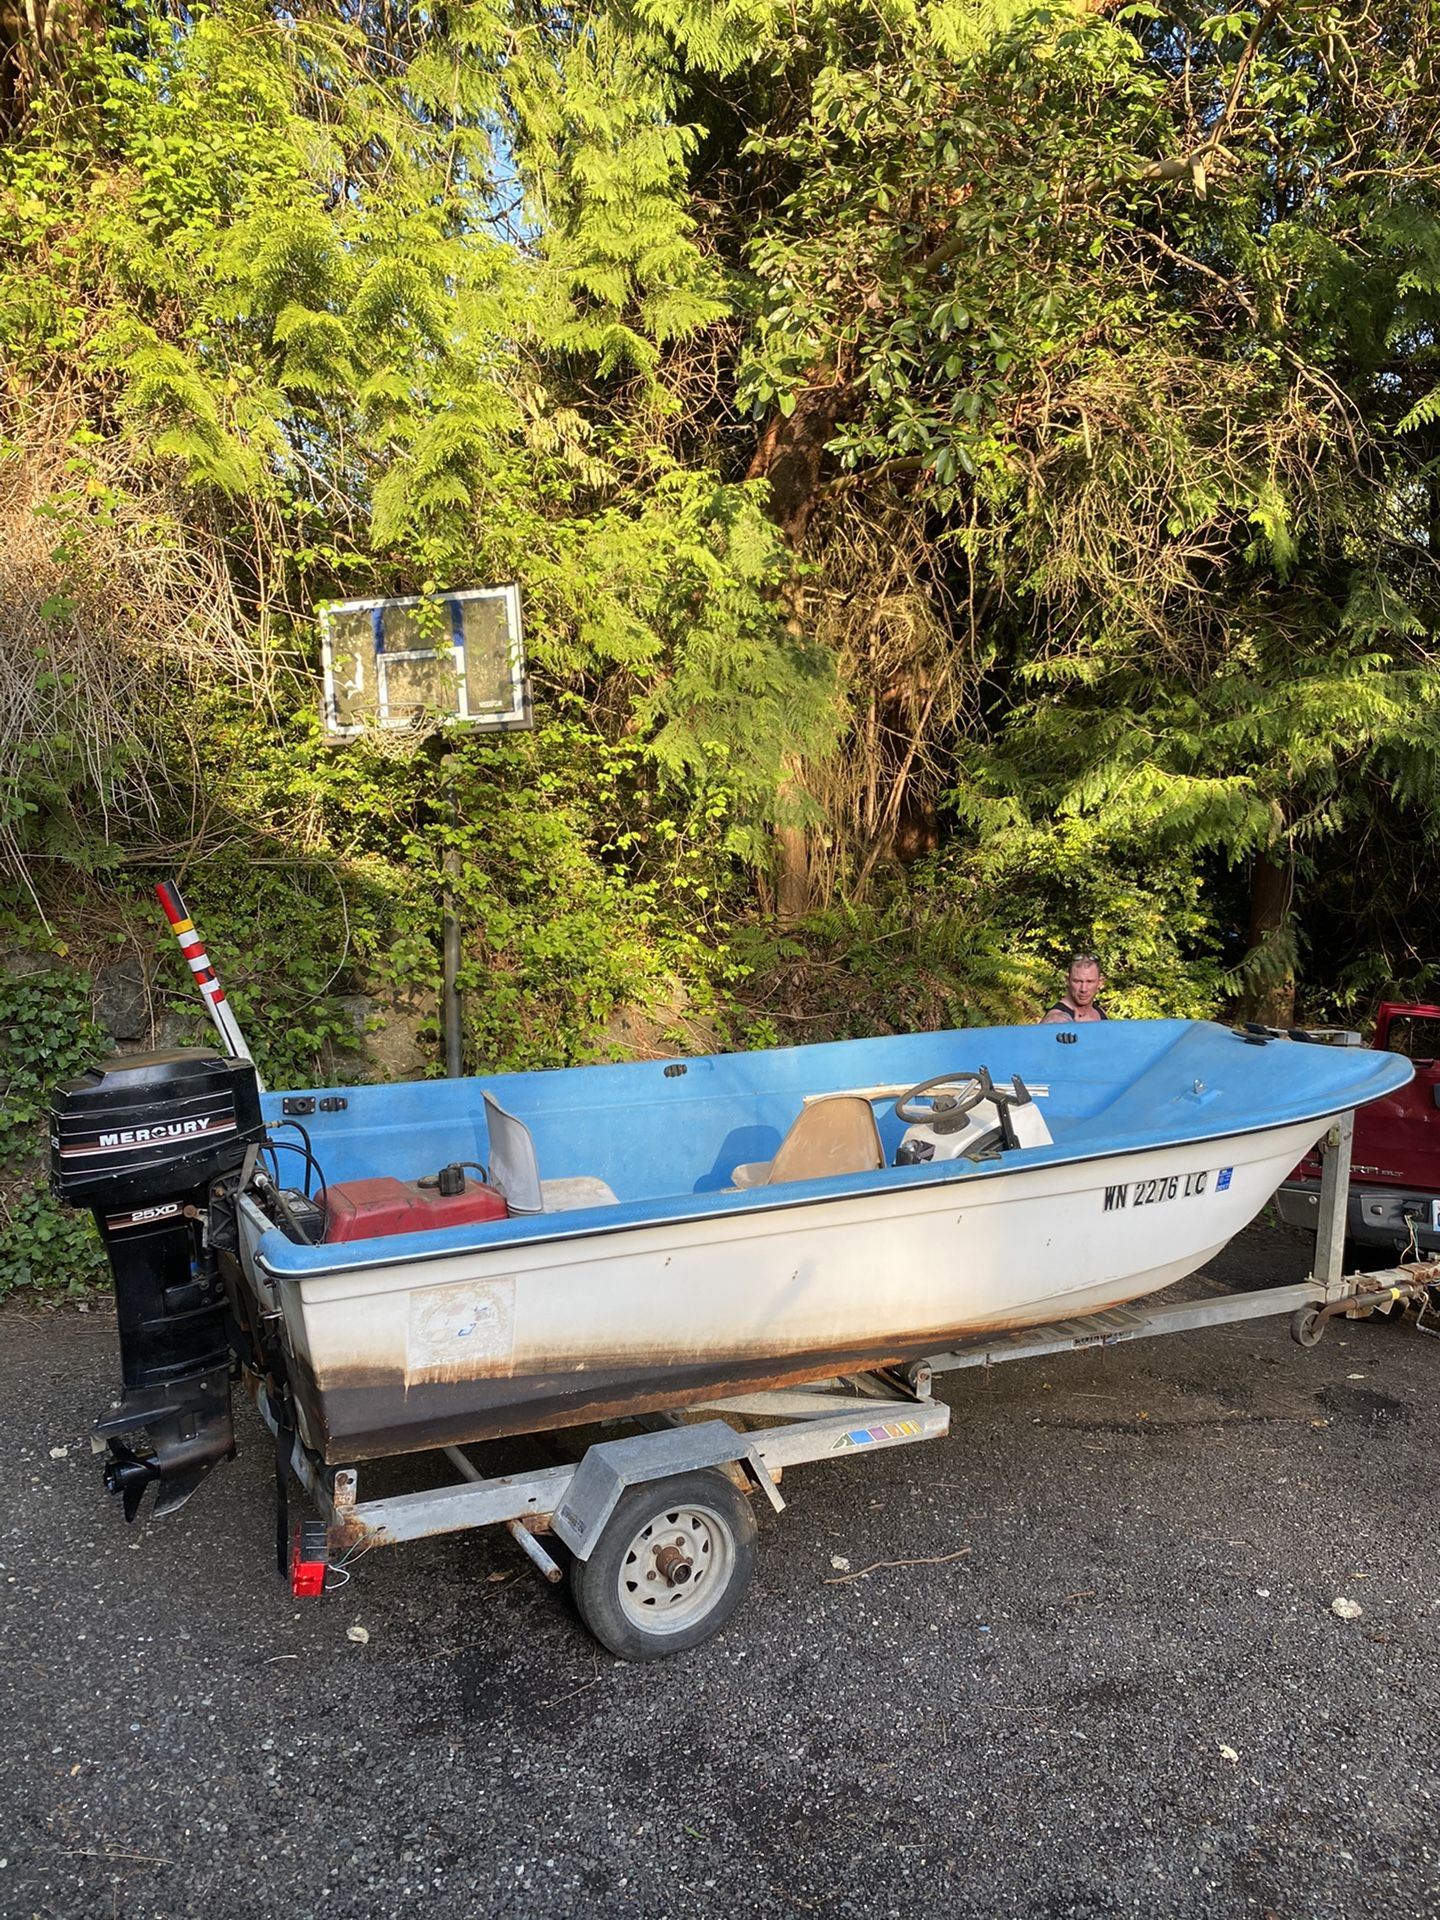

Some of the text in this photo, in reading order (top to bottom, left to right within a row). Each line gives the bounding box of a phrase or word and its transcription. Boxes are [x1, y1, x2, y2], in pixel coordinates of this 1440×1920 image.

[99, 1117, 210, 1147] MERCURY
[1104, 1184, 1128, 1211] WN
[1133, 1175, 1178, 1206] 2276
[132, 1203, 178, 1222] 25XD
